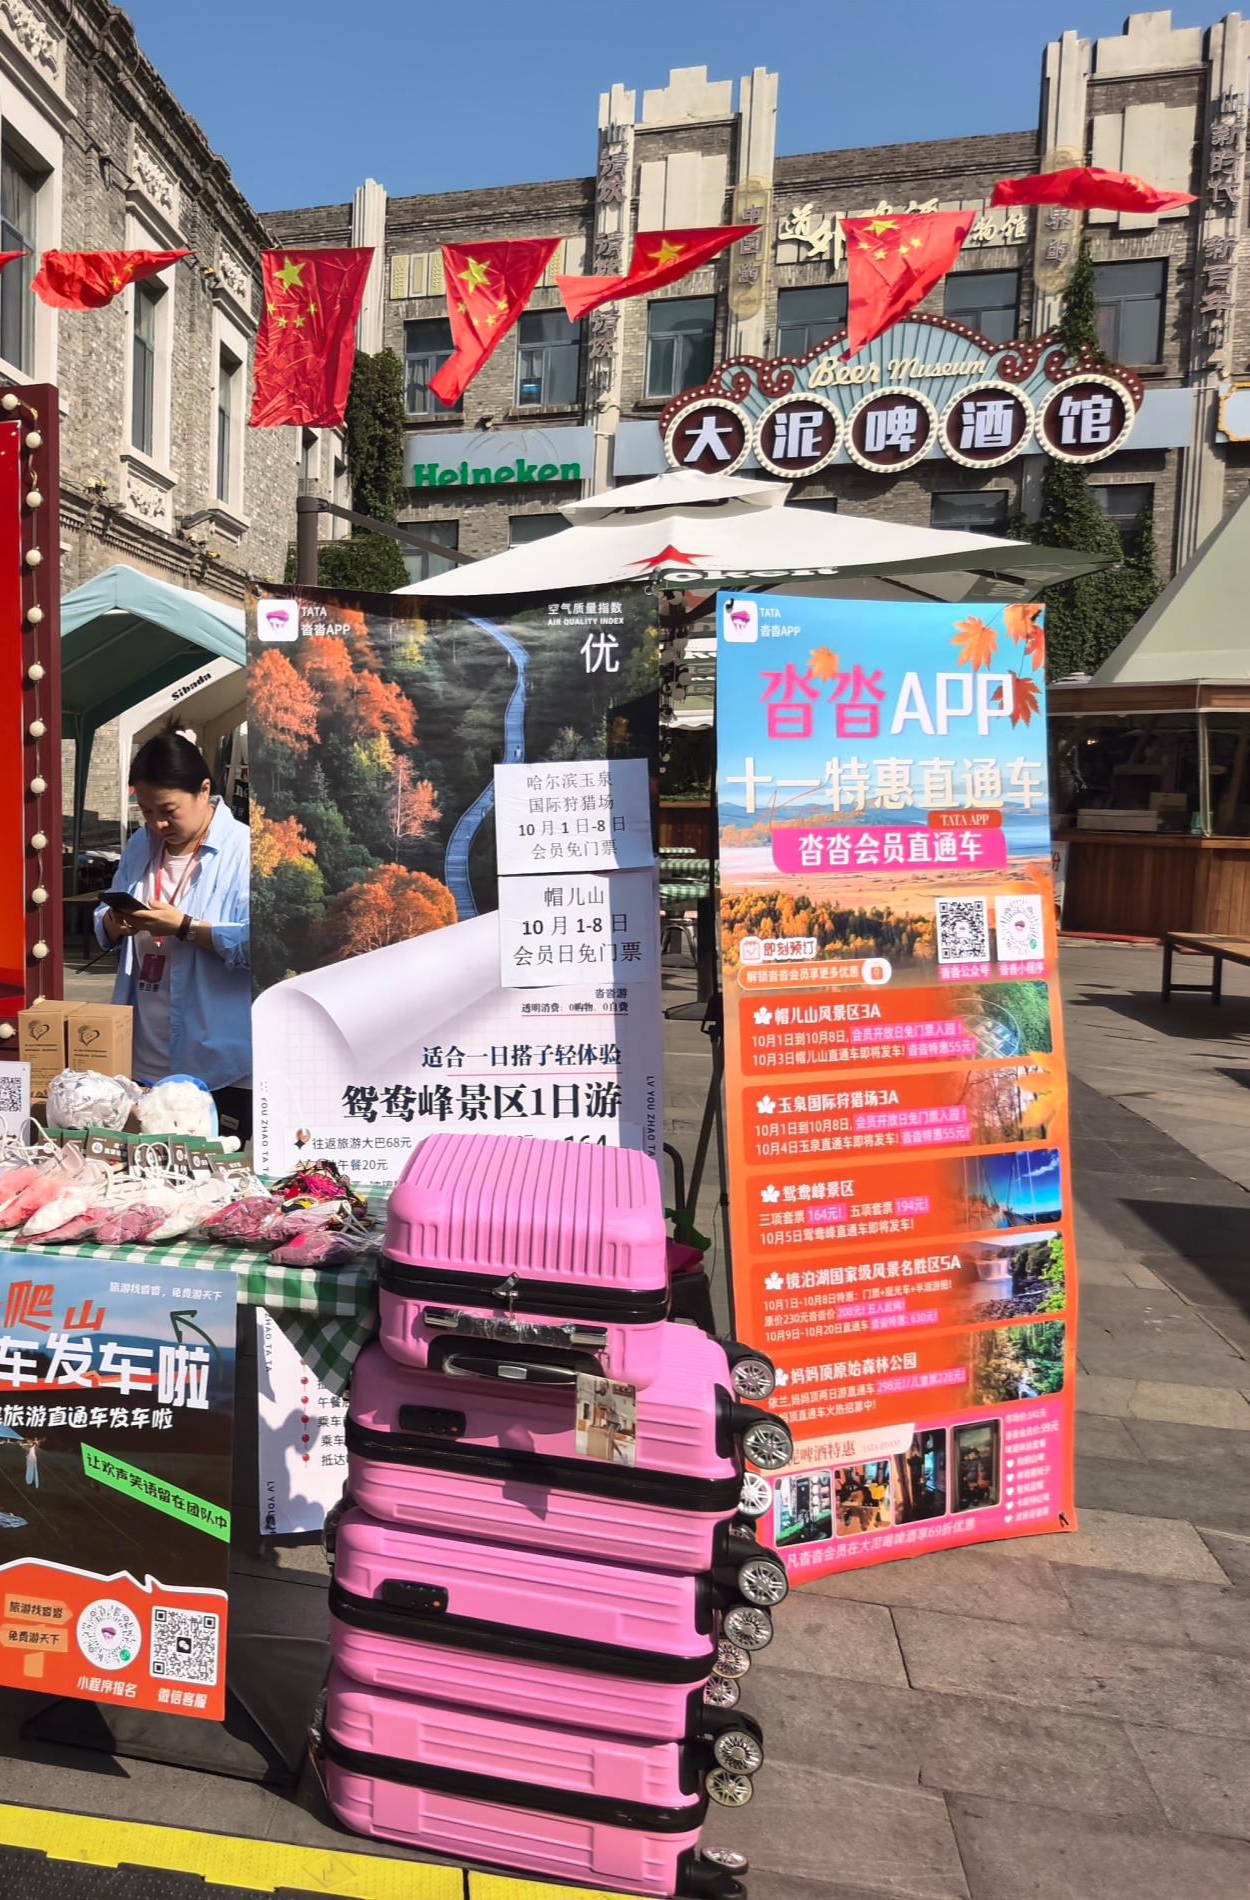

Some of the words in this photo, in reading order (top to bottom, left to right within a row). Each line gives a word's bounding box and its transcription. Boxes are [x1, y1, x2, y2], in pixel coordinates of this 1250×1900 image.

[808, 356, 880, 389] Beer
[887, 357, 989, 381] Museum
[684, 394, 1113, 463] 大泥啤酒馆
[413, 459, 581, 486] Heineken
[301, 607, 327, 617] TATA
[548, 602, 622, 615] 空气质量指数
[760, 608, 781, 618] TATA
[301, 624, 350, 637] 沓沓APP
[563, 617, 597, 626] QUALITY
[600, 617, 624, 625] INDEX
[760, 625, 800, 637] 沓沓APP
[580, 633, 619, 674] 优
[759, 663, 1015, 739] 沓沓APP
[527, 771, 613, 791] 哈尔滨玉泉
[726, 757, 1044, 814] 十一特惠直通车
[529, 794, 614, 813] 国际狩猎场
[941, 814, 968, 826] TATA
[970, 814, 989, 825] APP
[531, 840, 617, 860] 会员免门票
[798, 831, 983, 866] 沓沓会员直通车
[544, 886, 604, 907] 帽儿山
[513, 941, 642, 966] 会员日免门票
[764, 941, 814, 957] 即刻预订
[941, 965, 989, 979] 沓沓公众号
[1000, 962, 1044, 975] 沓沓小程序
[595, 988, 627, 999] 沓沓游
[775, 1004, 881, 1025] 帽儿山风景区3A
[422, 1044, 622, 1068] 适合一日搭子轻体验
[342, 1082, 622, 1123] 鸳鸯峰景区1日游
[779, 1090, 898, 1113] 玉泉国际狩猎场3A
[312, 1136, 412, 1150] 往返旅游大巴68元
[782, 1180, 854, 1202] 鸳鸯峰景区
[759, 1210, 805, 1227] 三项套票
[850, 1202, 893, 1218] 五项套票
[786, 1255, 961, 1289] 镜泊湖国家级风景名胜区5A
[791, 1352, 917, 1385] 妈妈顶原始森林公园
[87, 1453, 227, 1530] 让欢声笑语留在团队中
[9, 1601, 63, 1619] 旅游找沓沓
[8, 1630, 60, 1645] 免费游天下
[77, 1676, 137, 1697] 小程序报名
[158, 1687, 208, 1709] 微信客服
